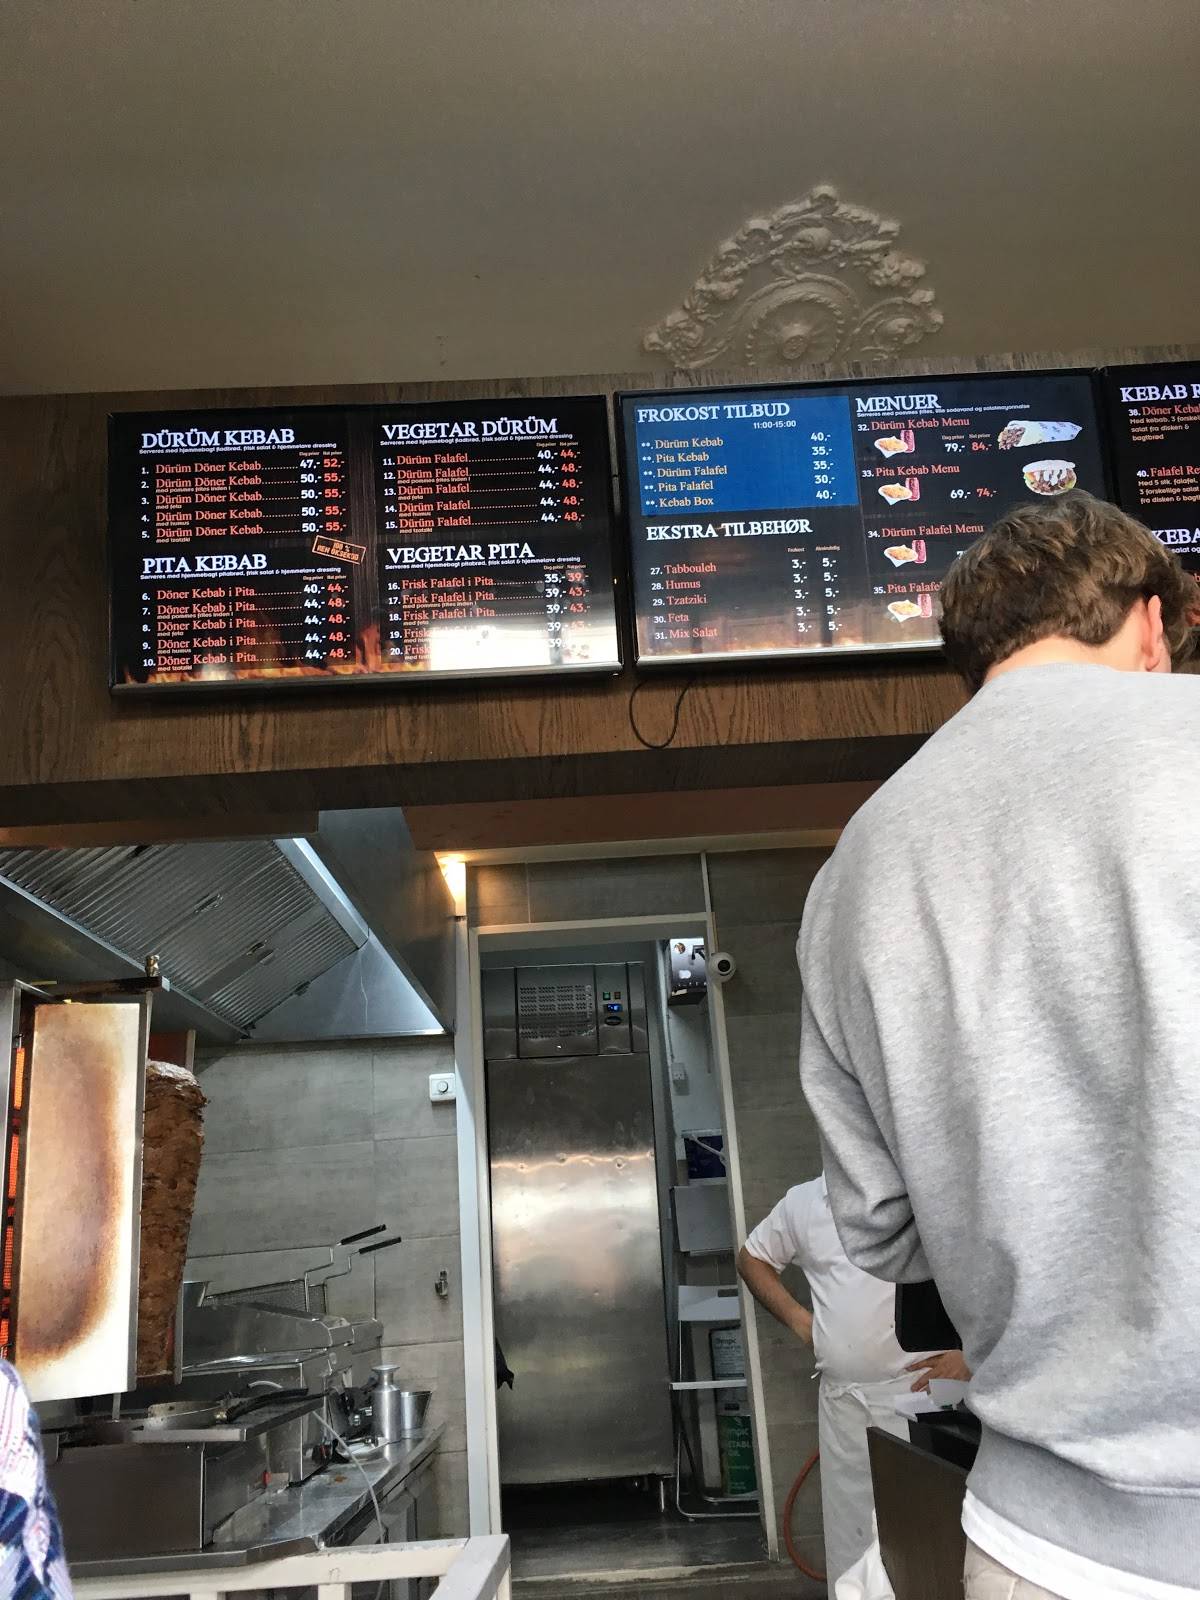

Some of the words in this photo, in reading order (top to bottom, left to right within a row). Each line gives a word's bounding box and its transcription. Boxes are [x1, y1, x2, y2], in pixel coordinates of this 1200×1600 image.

[1120, 384, 1188, 402] KEBAB
[856, 394, 942, 412] MENUER
[638, 406, 720, 422] FROKOST
[723, 402, 790, 419] TILBUD
[1142, 406, 1172, 416] Döner
[382, 422, 478, 440] VEGETAR
[482, 416, 558, 436] DÜRÜM
[754, 420, 796, 429] 11:00-15:00
[858, 424, 870, 432] 32.
[872, 421, 905, 430] Dürüm
[908, 418, 940, 428] Kebab
[942, 418, 970, 427] Menu
[141, 428, 220, 448] DÜRÜM
[224, 428, 296, 446] KEBAB
[655, 440, 689, 450] Dürüm
[692, 437, 724, 448] Kebab
[383, 458, 396, 466] 11.
[396, 455, 432, 465] Dürüm
[434, 452, 468, 464] Falafel
[656, 454, 675, 463] Pita
[678, 452, 710, 462] Kebab
[156, 464, 192, 474] Dürüm
[194, 462, 226, 472] Döner
[228, 461, 262, 471] Kebab
[384, 472, 396, 480] 12.
[398, 469, 432, 480] Dürüm
[435, 466, 469, 478] Falafel
[657, 468, 692, 478] Dürüm
[694, 465, 728, 476] Falafel
[862, 470, 874, 478] 33.
[876, 467, 895, 476] Pita
[898, 465, 929, 476] Kebab
[931, 464, 960, 474] Menu
[1150, 466, 1184, 476] Falafel
[156, 478, 192, 488] Dürüm
[194, 477, 226, 487] Döner
[228, 475, 262, 486] Kebab
[658, 482, 678, 492] Pita
[680, 480, 714, 490] Falafel
[384, 488, 396, 496] 13.
[398, 486, 433, 496] Dürüm
[436, 483, 470, 494] Falafel
[156, 494, 192, 504] Dürüm
[195, 493, 226, 502] Döner
[229, 491, 262, 502] Kebab
[659, 497, 691, 508] Kebab
[694, 496, 714, 506] Box
[141, 514, 150, 522] 4.
[156, 512, 192, 522] Dürüm
[195, 510, 227, 520] Döner
[229, 508, 262, 518] Kebab
[156, 528, 192, 538] Dürüm
[196, 526, 227, 536] Döner
[230, 524, 263, 534] Kebab
[646, 524, 718, 540] EKSTRA
[720, 518, 813, 537] TILBEHØR
[868, 530, 880, 538] 34.
[882, 528, 916, 538] Dürüm
[919, 525, 952, 536] Falafel
[955, 524, 985, 534] Menu
[386, 544, 486, 564] VEGETAR
[488, 542, 536, 560] PITA
[142, 556, 192, 574] PITA
[195, 554, 268, 572] KEBAB
[664, 562, 717, 574] Tabbouleh
[402, 579, 428, 590] Frisk
[430, 577, 465, 588] Falafel
[474, 576, 494, 586] Pita
[652, 582, 664, 590] 28.
[666, 580, 701, 590] Humus
[874, 586, 886, 594] 35.
[888, 584, 906, 594] Pita
[142, 592, 150, 600] 6.
[157, 590, 190, 600] Döner
[192, 588, 225, 598] Kebab
[236, 586, 255, 596] Pita
[142, 608, 150, 616] 7.
[157, 604, 190, 615] Döner
[192, 603, 226, 613] Kebab
[236, 602, 255, 612] Pita
